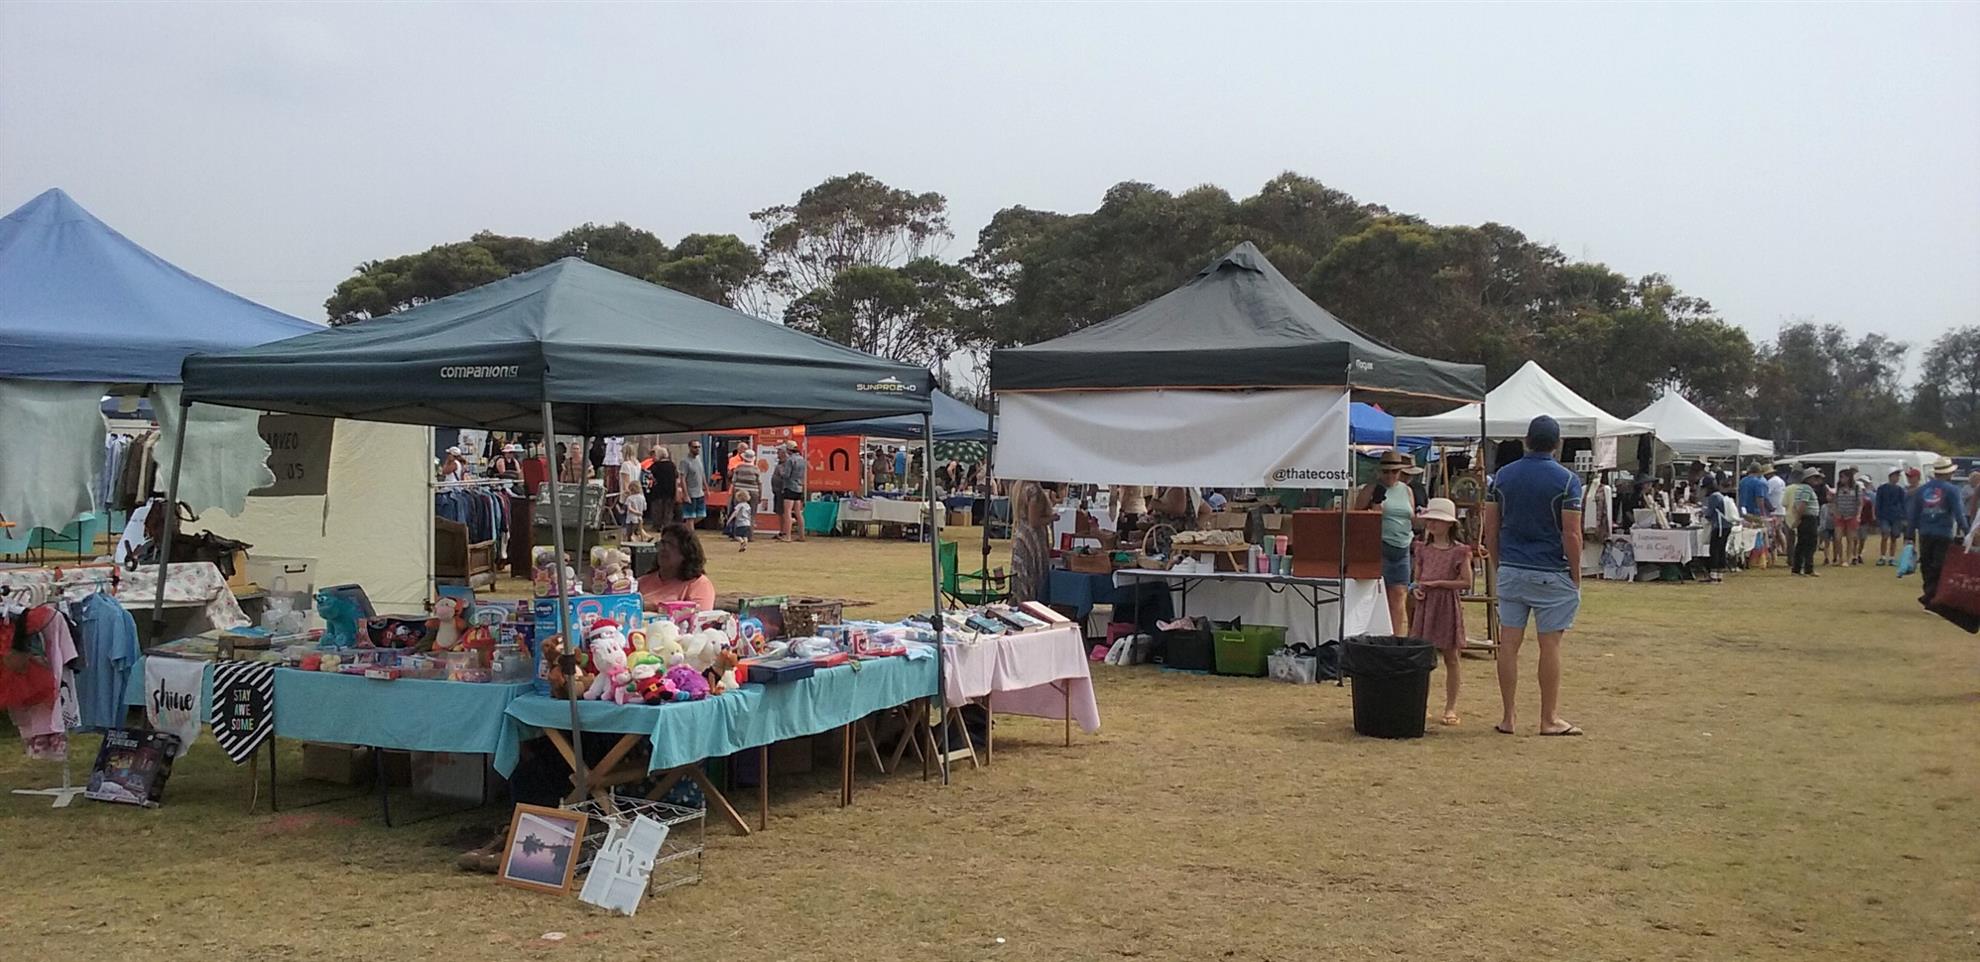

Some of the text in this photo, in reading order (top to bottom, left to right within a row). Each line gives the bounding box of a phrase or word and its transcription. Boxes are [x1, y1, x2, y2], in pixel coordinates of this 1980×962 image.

[152, 678, 195, 715] shine
[233, 689, 251, 701] STAY
[234, 704, 251, 716] AWE
[231, 718, 254, 731] SOME
